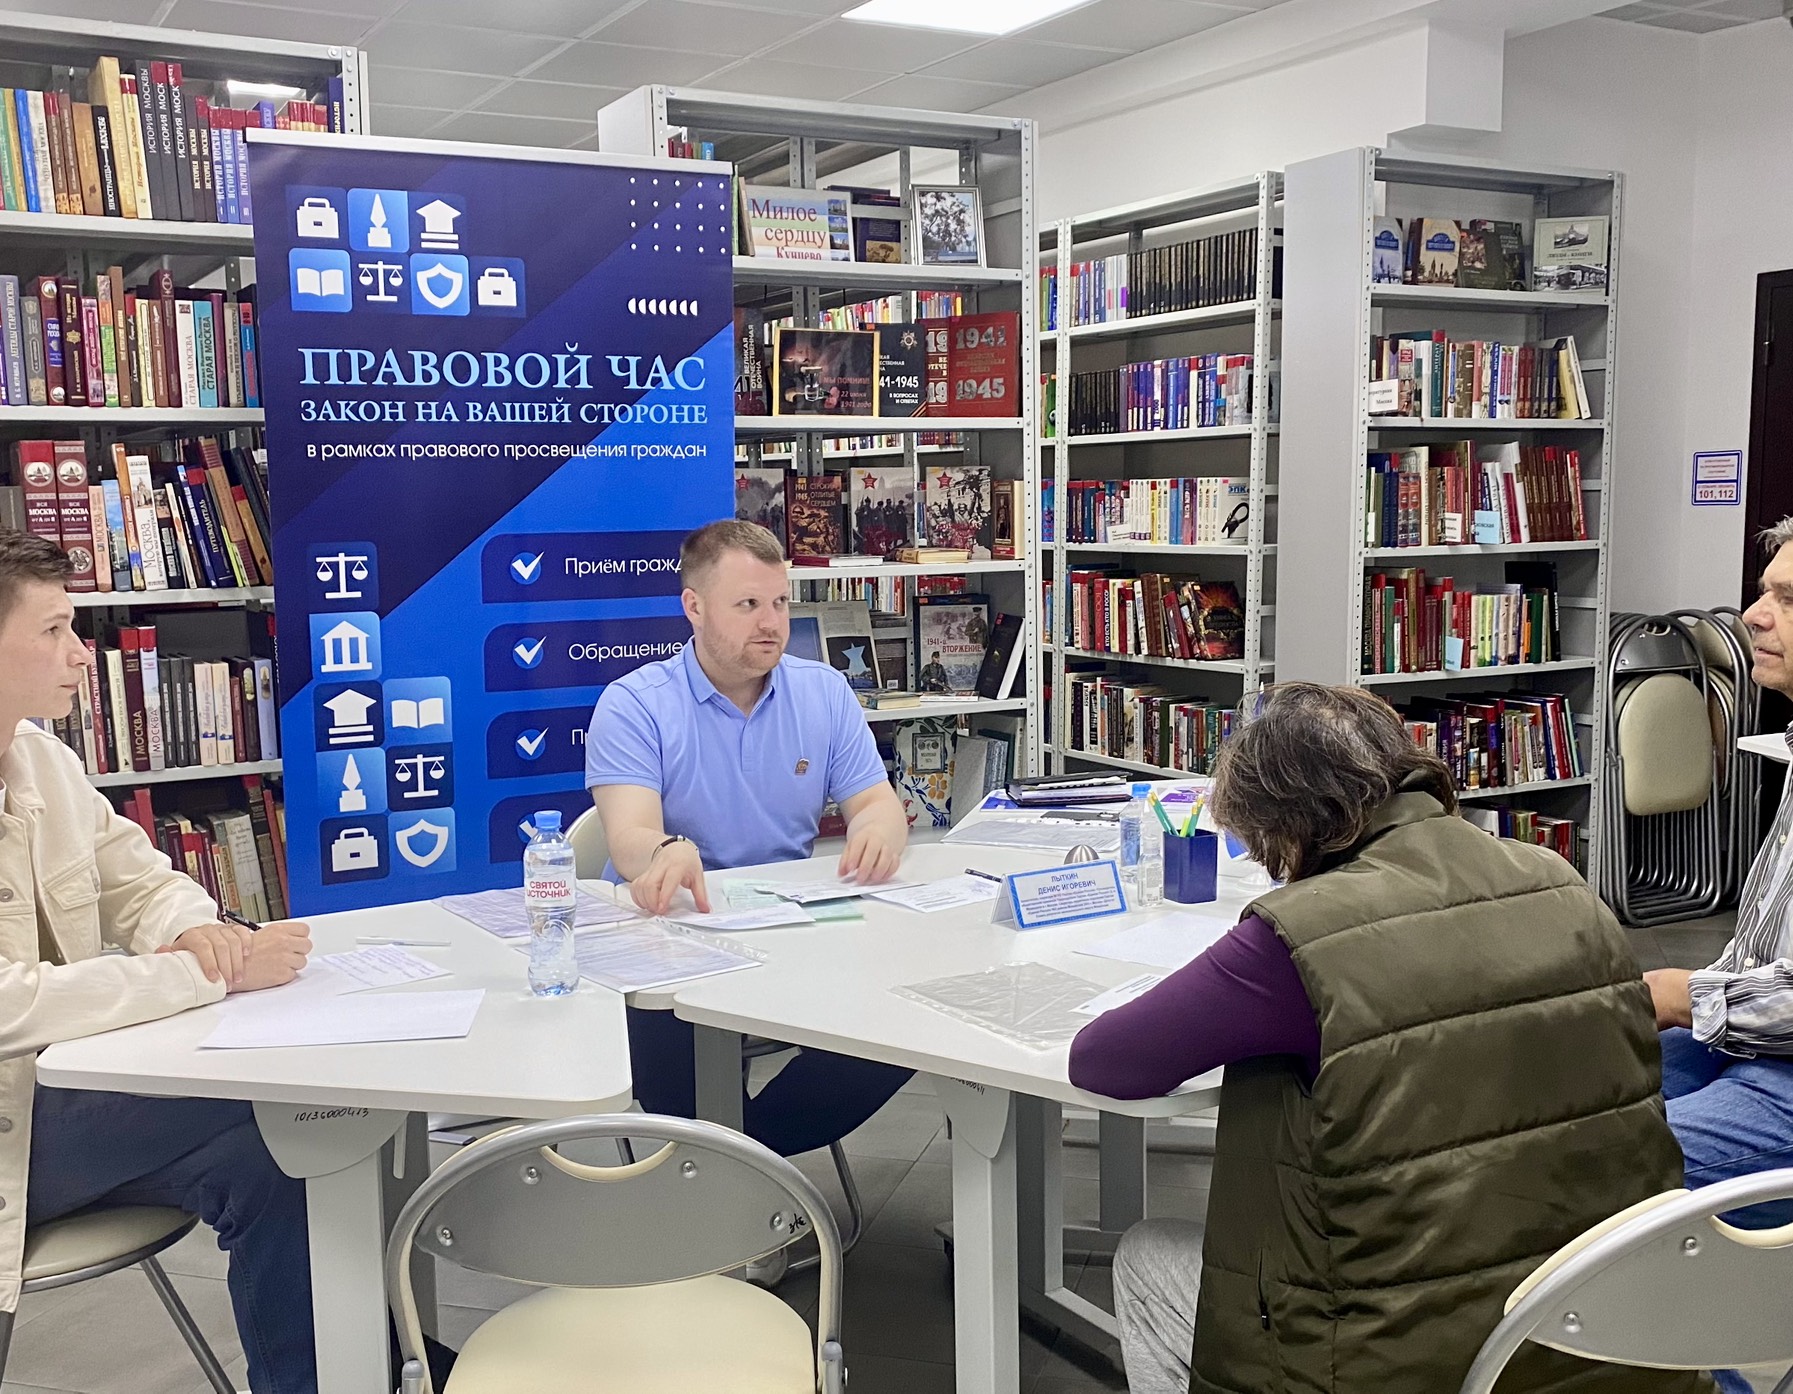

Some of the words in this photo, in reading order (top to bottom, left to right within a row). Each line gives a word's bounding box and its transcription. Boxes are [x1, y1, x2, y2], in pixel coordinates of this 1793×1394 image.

[140, 68, 152, 109] МОСКВЫ
[157, 82, 167, 110] МОСК
[171, 85, 183, 114] МОСК
[145, 113, 157, 154] ИСТОРИЯ
[160, 114, 171, 154] ИСТОРИЯ
[174, 118, 186, 158] ИСТОРИЯ
[189, 128, 199, 156] МОСКВЫ
[200, 128, 210, 156] МОСКВЫ
[210, 129, 221, 160] МОСКВЫ
[221, 128, 233, 160] МОСКВЫ
[192, 161, 201, 189] ИСТОРИЯ
[203, 161, 213, 190] ИСТОРИЯ
[213, 165, 225, 200] ИСТОРИЯ
[225, 163, 236, 199] ИСТОРИЯ
[237, 163, 249, 196] ИСТОРИЯ
[751, 198, 818, 222] Милое
[764, 226, 828, 248] сердцу
[776, 246, 823, 260] Кунцево
[6, 281, 16, 307] МОСКВЫ
[8, 307, 18, 330] СТАРОЙ
[10, 330, 20, 359] ЛЕГЕНДЫ
[203, 316, 213, 354] МОСКВА
[926, 331, 948, 353] 19
[956, 326, 1007, 350] 1941
[185, 335, 195, 370] МОСКВА
[297, 342, 593, 390] ПРАВОВОЙ
[605, 355, 707, 391] ЧАС
[748, 325, 757, 389] ОТЕЧЕСТВЕННАЯ
[205, 356, 215, 390] СТАРАЯ
[755, 361, 763, 390] ВОЙНА
[879, 375, 919, 388] 41-1945
[187, 373, 197, 406] СТАРАЯ
[926, 382, 948, 403] 19
[956, 377, 1006, 400] 1945
[300, 399, 406, 422] ЗАКОН
[415, 400, 460, 422] НА
[466, 397, 572, 424] ВАШЕЙ
[579, 403, 708, 424] СТОРОНЕ
[307, 445, 317, 457] в
[321, 444, 396, 461] рамках
[400, 444, 500, 461] правового
[504, 444, 627, 461] просвещения
[631, 444, 707, 461] граждан
[1699, 490, 1717, 499] 101,
[1718, 490, 1734, 498] 112
[29, 508, 57, 516] МОСКВА
[149, 509, 159, 539] потеряли
[199, 499, 219, 553] ПУТЕВОДИТЕЛЬ
[154, 550, 164, 578] которую
[564, 557, 626, 578] Приём
[629, 556, 682, 575] гражд
[1364, 576, 1373, 629] ПРИФРОНТОВАЯ
[568, 641, 683, 663] Обращение
[942, 645, 982, 653] ВТОРЖЕНИЕ
[1364, 629, 1373, 656] МОСКВА
[89, 645, 99, 675] БУЛАР
[92, 676, 103, 715] СТРАСТНОЙ
[133, 710, 148, 756] МОСКВА
[150, 708, 162, 753] МОСКВА
[526, 888, 571, 898] ИСТОЧНИК
[530, 880, 567, 890] СВЯТОЙ
[1038, 883, 1061, 895] ДЕНИС
[1061, 880, 1097, 891] ИГОРЕВИЧ
